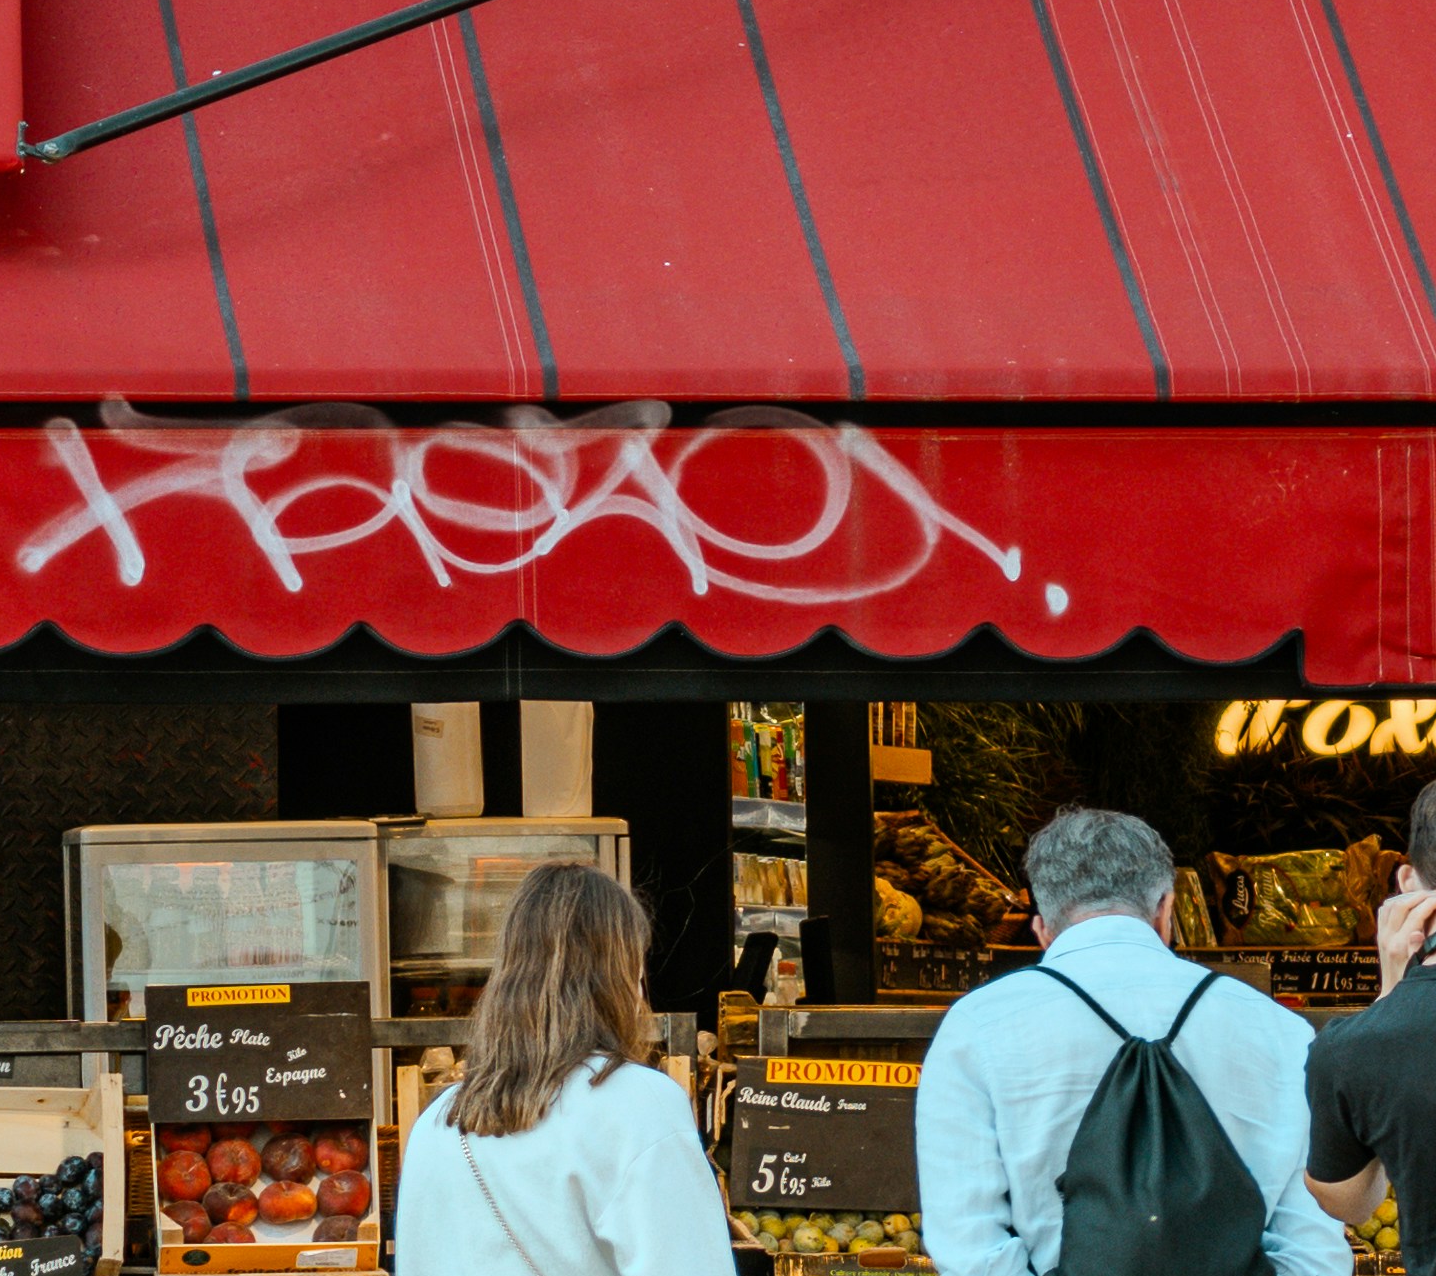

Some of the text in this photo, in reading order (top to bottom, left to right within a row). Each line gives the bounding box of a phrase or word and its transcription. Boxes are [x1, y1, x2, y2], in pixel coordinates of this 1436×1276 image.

[1232, 875, 1249, 915] Lucas
[1281, 950, 1311, 963] Frisée
[1316, 952, 1347, 964] Castel
[191, 988, 287, 1003] PROMOTION
[153, 1024, 224, 1050] Pêche
[229, 1028, 270, 1047] Plate
[266, 1067, 327, 1086] Espagne
[737, 1086, 778, 1106] Reine
[781, 1091, 831, 1113] Claude
[30, 1252, 76, 1276] France
